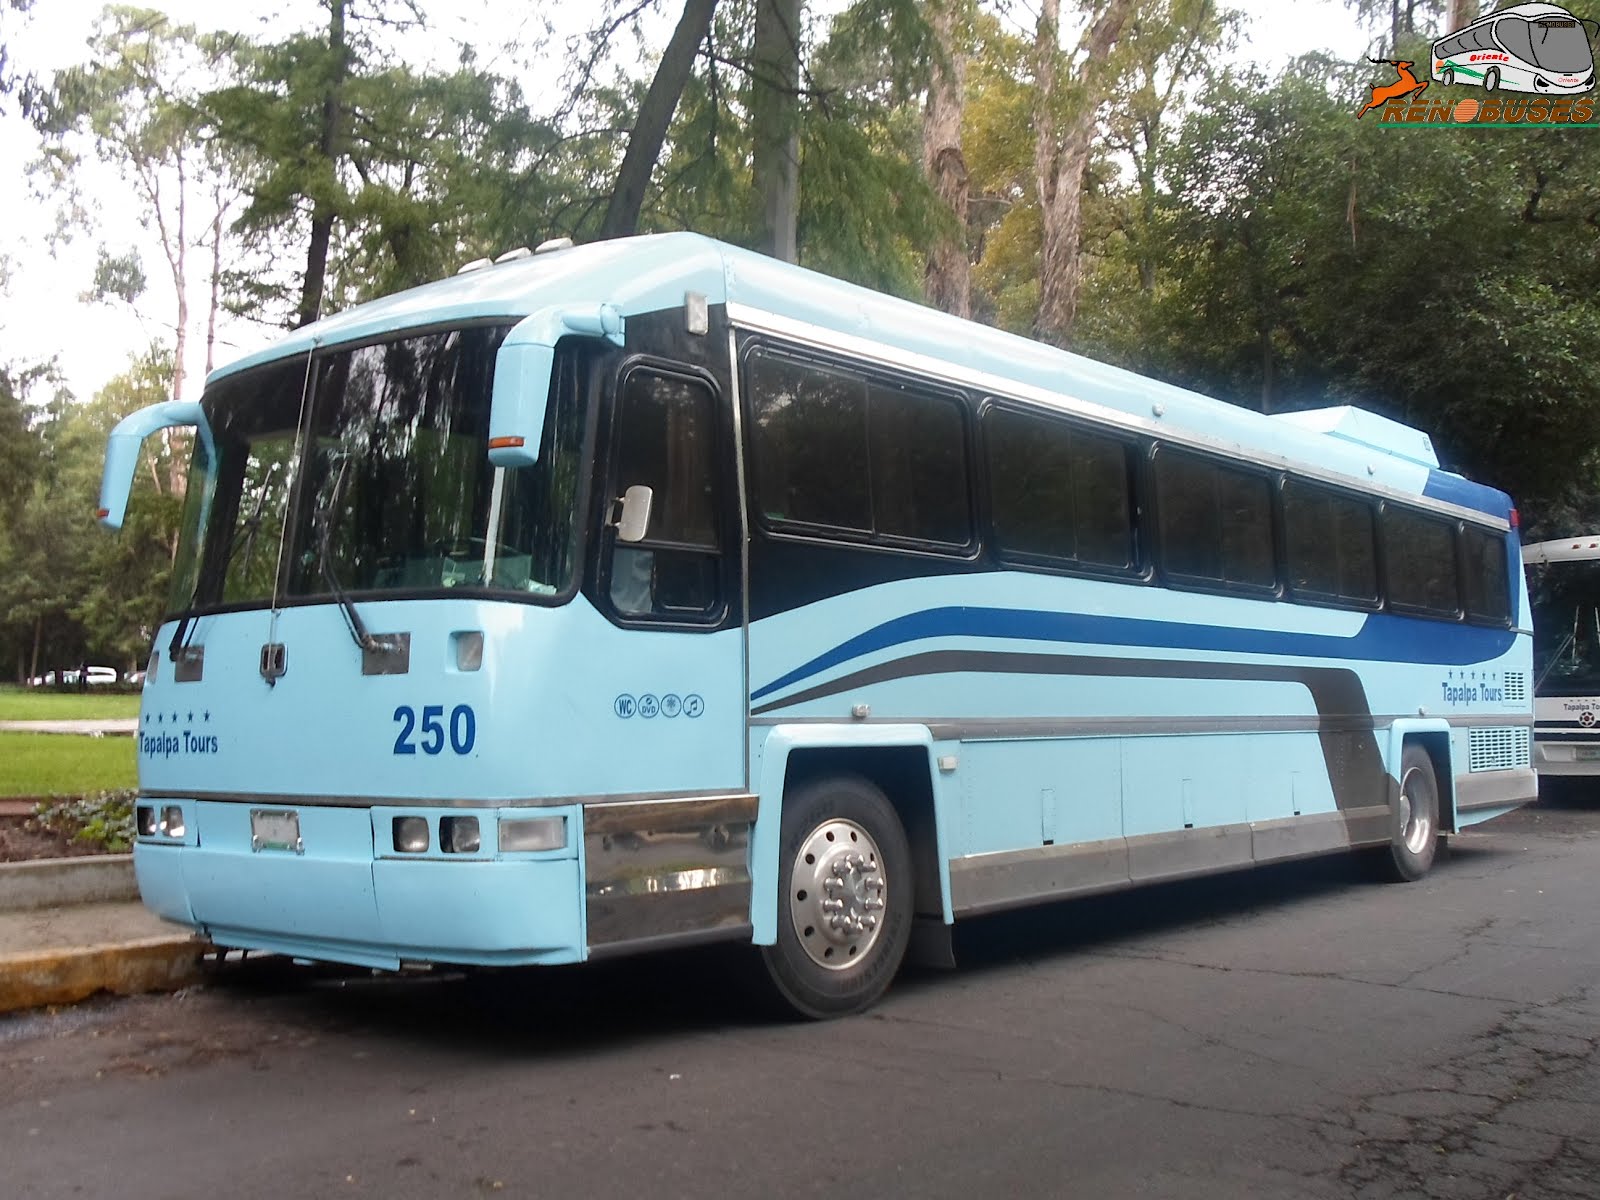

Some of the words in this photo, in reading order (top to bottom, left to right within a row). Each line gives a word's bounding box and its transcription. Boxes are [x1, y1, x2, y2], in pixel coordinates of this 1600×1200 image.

[1442, 682, 1477, 706] Tapalpa
[1480, 683, 1502, 702] Tours
[618, 699, 632, 715] WC
[641, 705, 656, 714] DVD
[1563, 703, 1590, 712] Tapalpa
[393, 704, 476, 755] 250
[139, 731, 179, 759] Tapalpa
[183, 730, 218, 753] Tours
